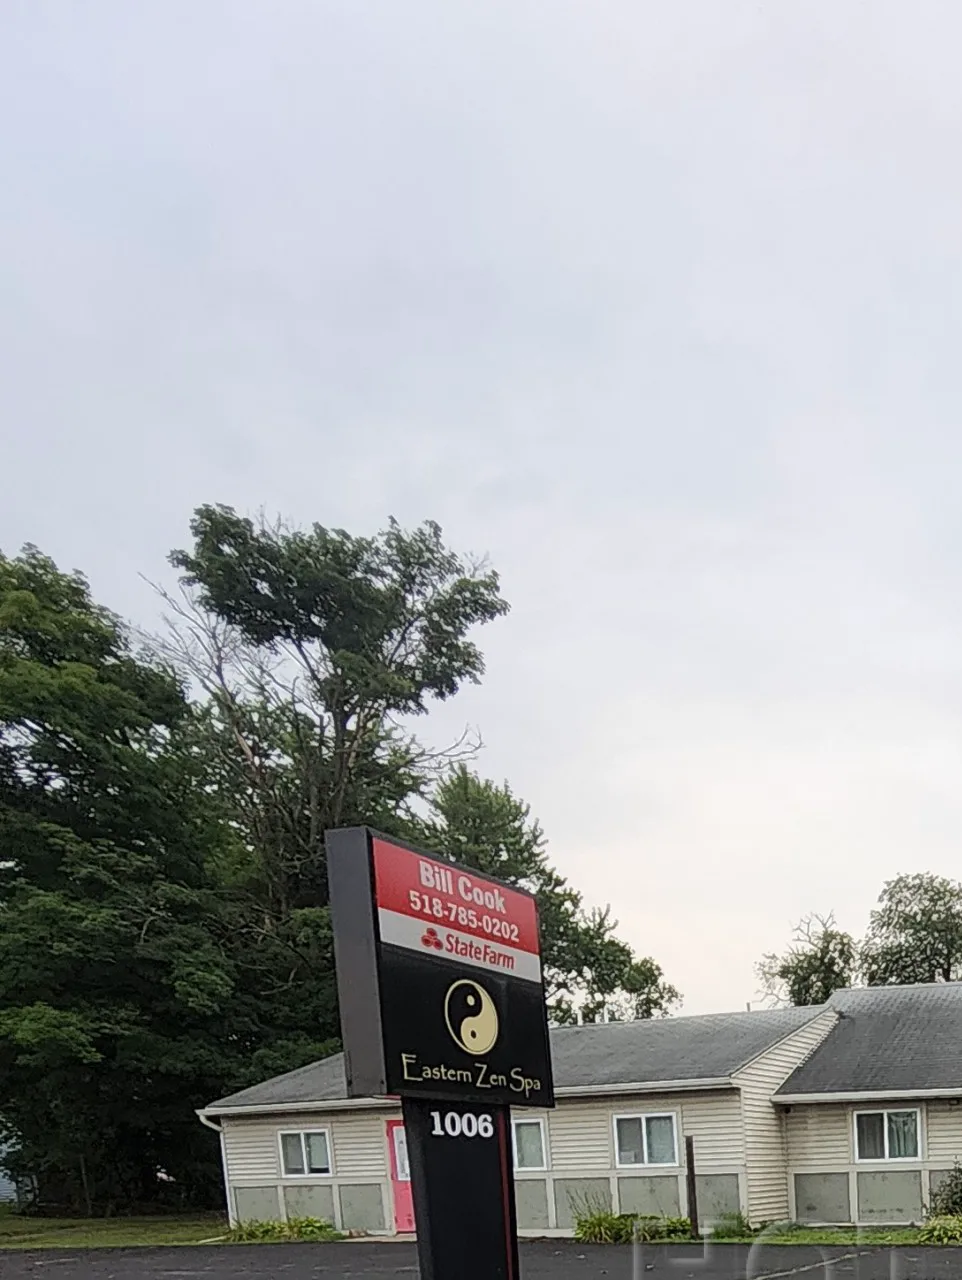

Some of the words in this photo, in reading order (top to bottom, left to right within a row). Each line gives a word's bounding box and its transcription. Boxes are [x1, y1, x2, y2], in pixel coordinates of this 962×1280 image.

[419, 860, 454, 895] Bill
[458, 875, 507, 914] Cook
[409, 889, 520, 942] 518-785-0202
[401, 1052, 472, 1083] Eastern
[474, 1062, 507, 1088] Zen
[509, 1067, 541, 1098] Spa
[430, 1111, 494, 1138] 1006
